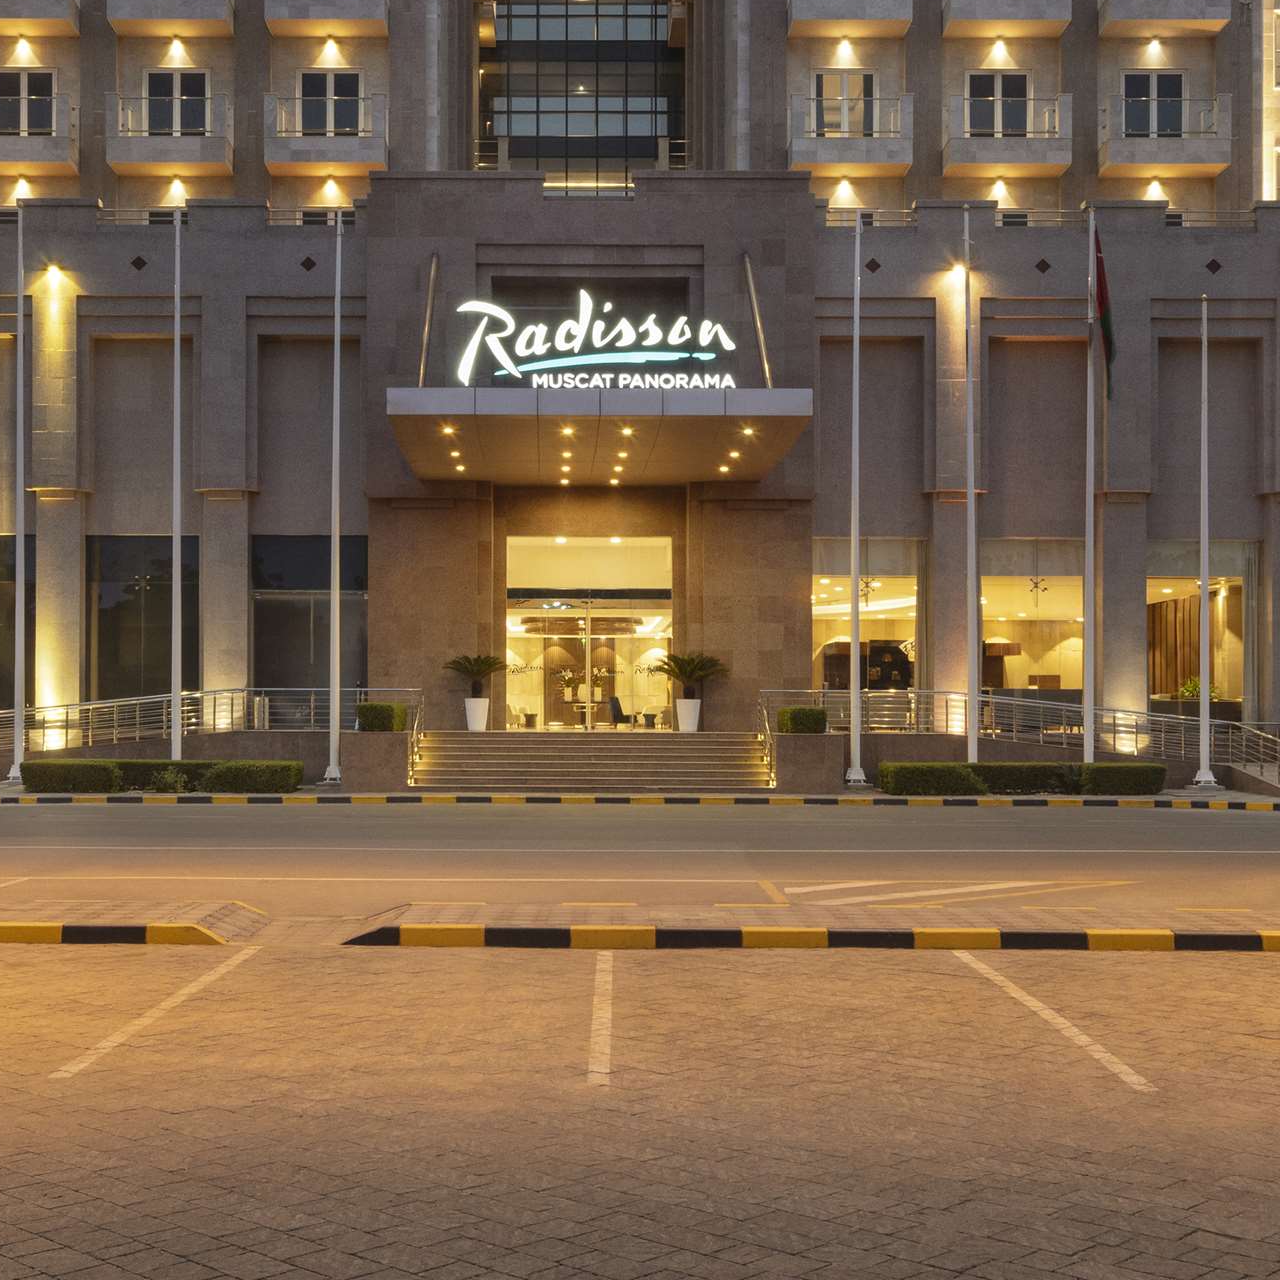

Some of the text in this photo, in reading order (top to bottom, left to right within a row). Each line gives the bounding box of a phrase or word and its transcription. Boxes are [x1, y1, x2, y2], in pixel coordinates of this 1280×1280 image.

[456, 289, 737, 387] Radisson
[532, 373, 736, 389] MUSCAT PANORAMA
